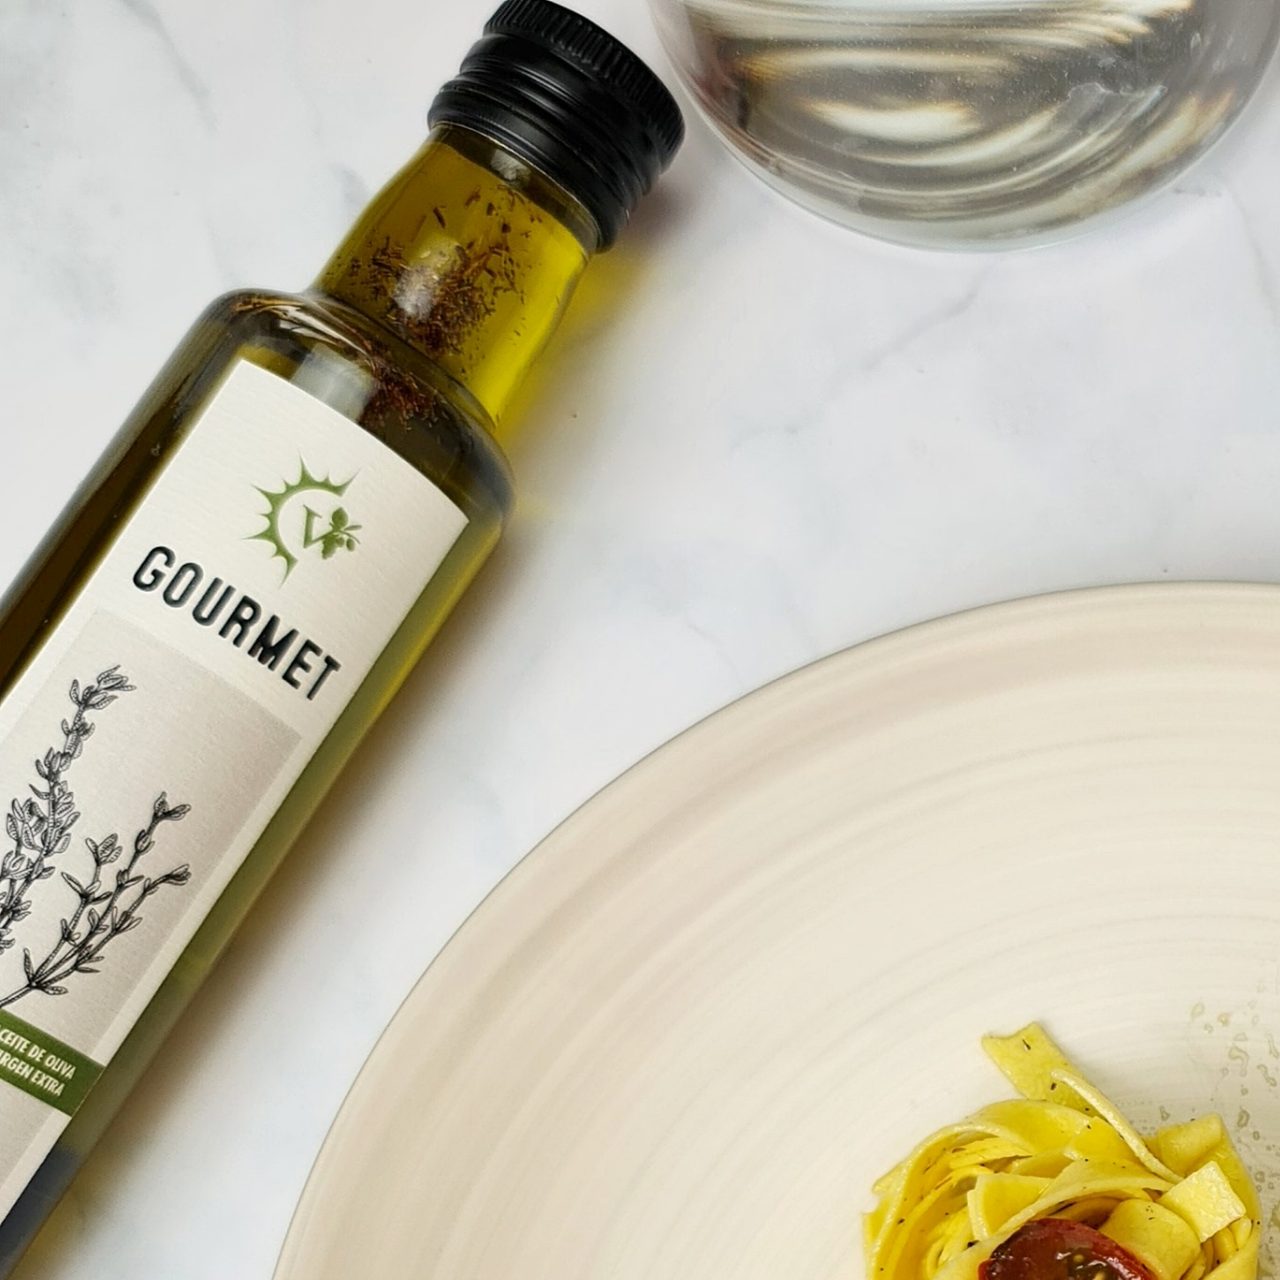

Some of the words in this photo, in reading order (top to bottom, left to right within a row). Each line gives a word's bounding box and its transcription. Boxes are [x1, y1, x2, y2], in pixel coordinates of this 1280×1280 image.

[133, 546, 341, 701] GOURMET
[0, 1025, 31, 1053] CEITE
[28, 1044, 47, 1062] DE
[45, 1055, 76, 1079] OLIVA
[31, 1070, 65, 1096] EXTRA
